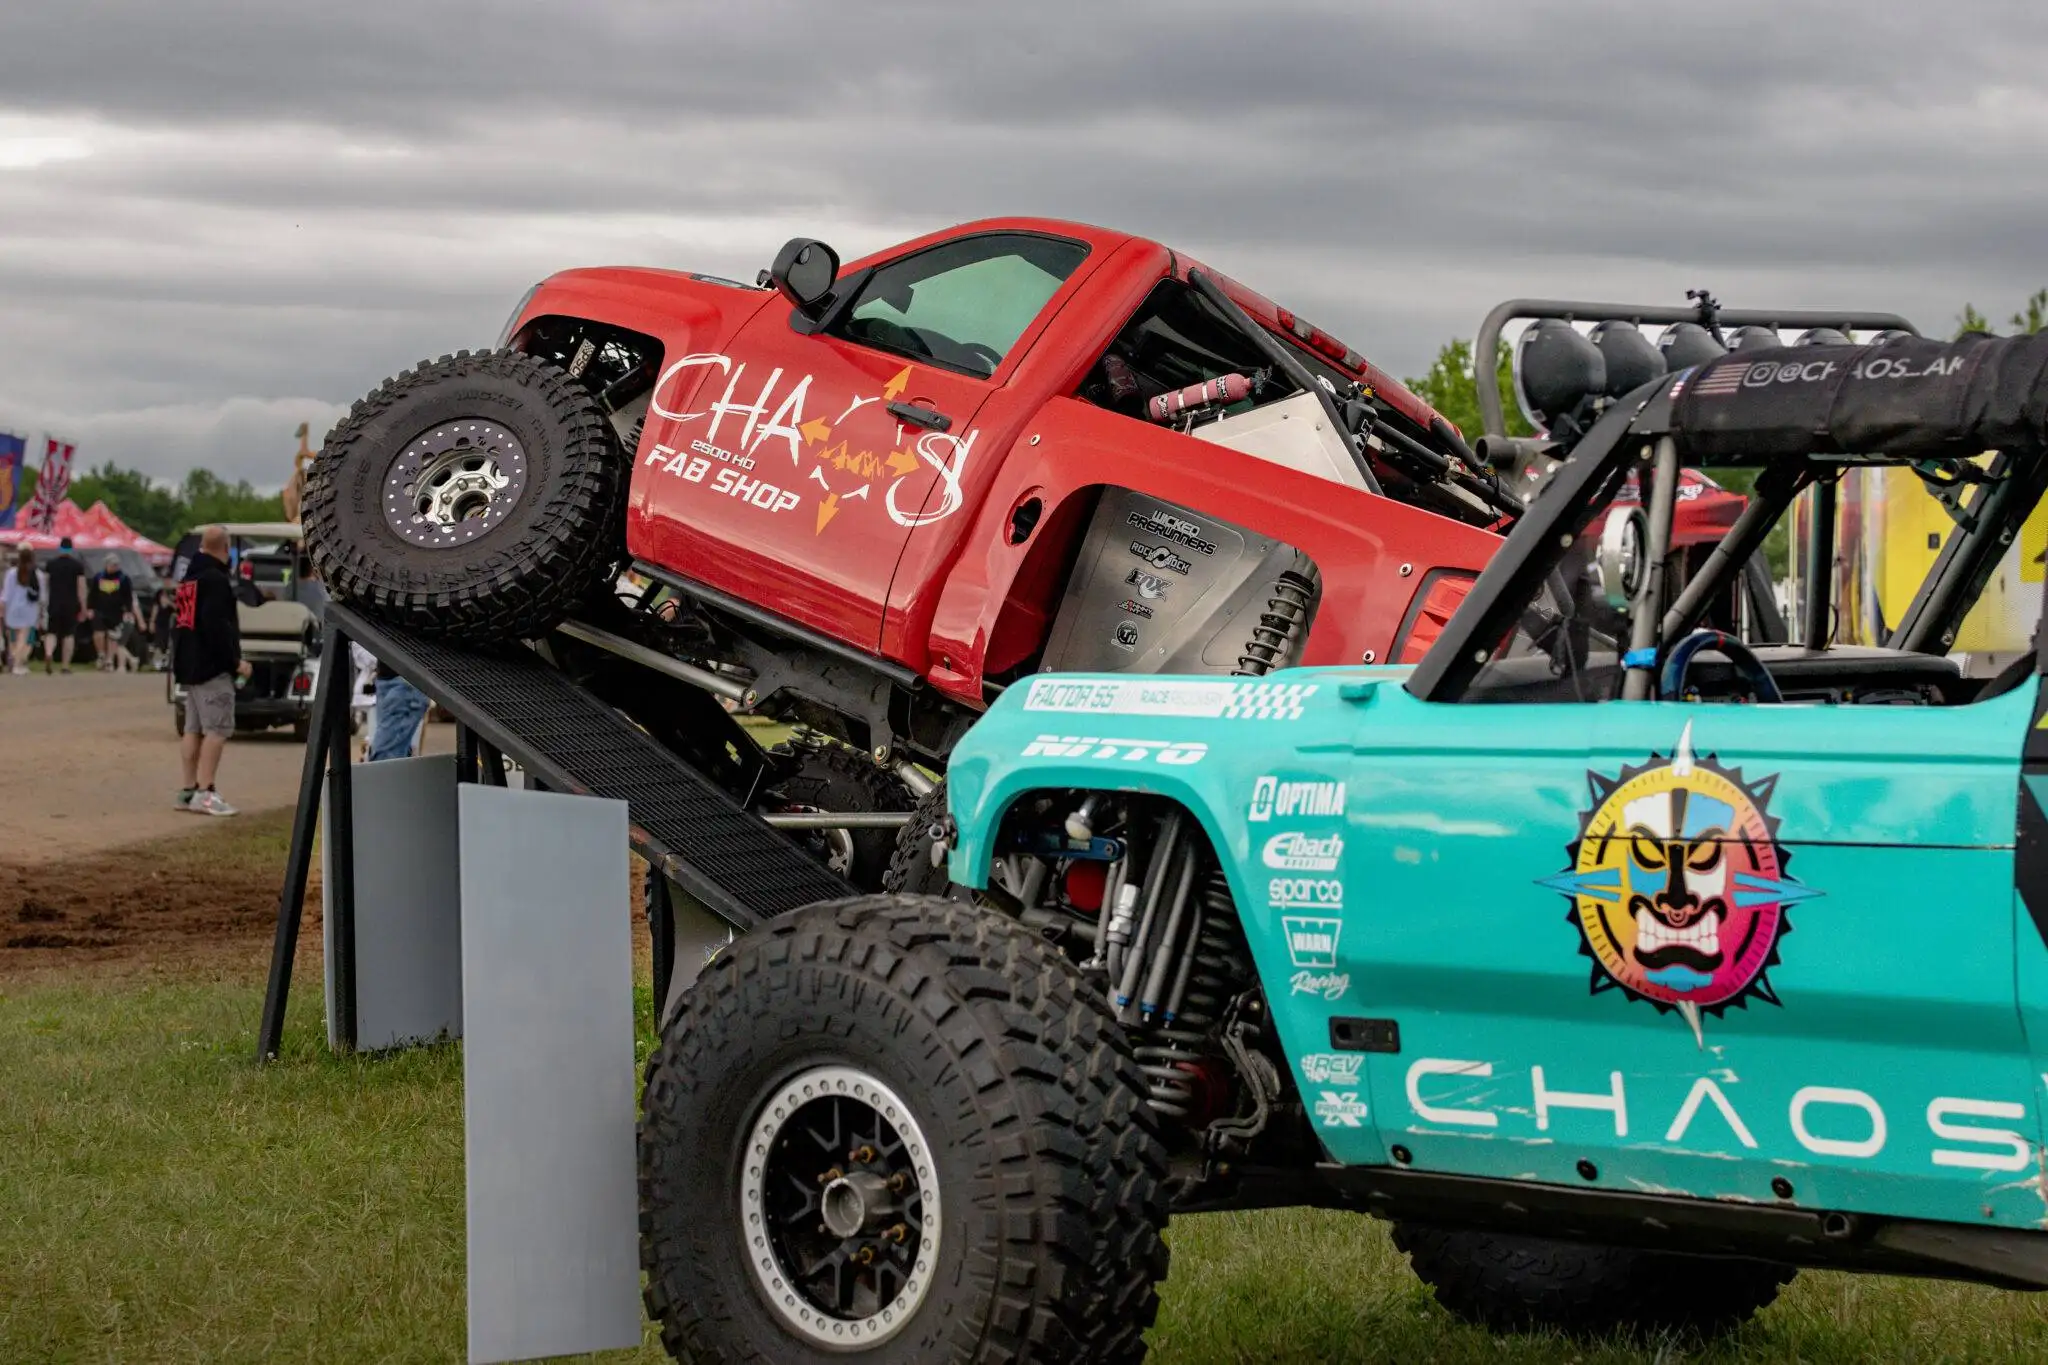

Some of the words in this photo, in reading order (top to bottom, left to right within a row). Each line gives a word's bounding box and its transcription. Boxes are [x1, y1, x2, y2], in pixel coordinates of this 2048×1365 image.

[690, 439, 732, 462] 2500
[644, 443, 712, 484] FAB
[709, 467, 801, 513] SHOP
[1126, 511, 1218, 556] PRERUNNERS
[1151, 510, 1201, 537] WICKED
[1130, 541, 1157, 562] ROCK
[1030, 683, 1095, 708] FACTOR
[1090, 685, 1120, 709] 55
[1020, 735, 1209, 765] NITTO
[1275, 781, 1346, 816] OPTIMA
[1262, 831, 1344, 871] Eibach
[1268, 878, 1344, 910] sparco
[1405, 1058, 2031, 1172] CHAOS
